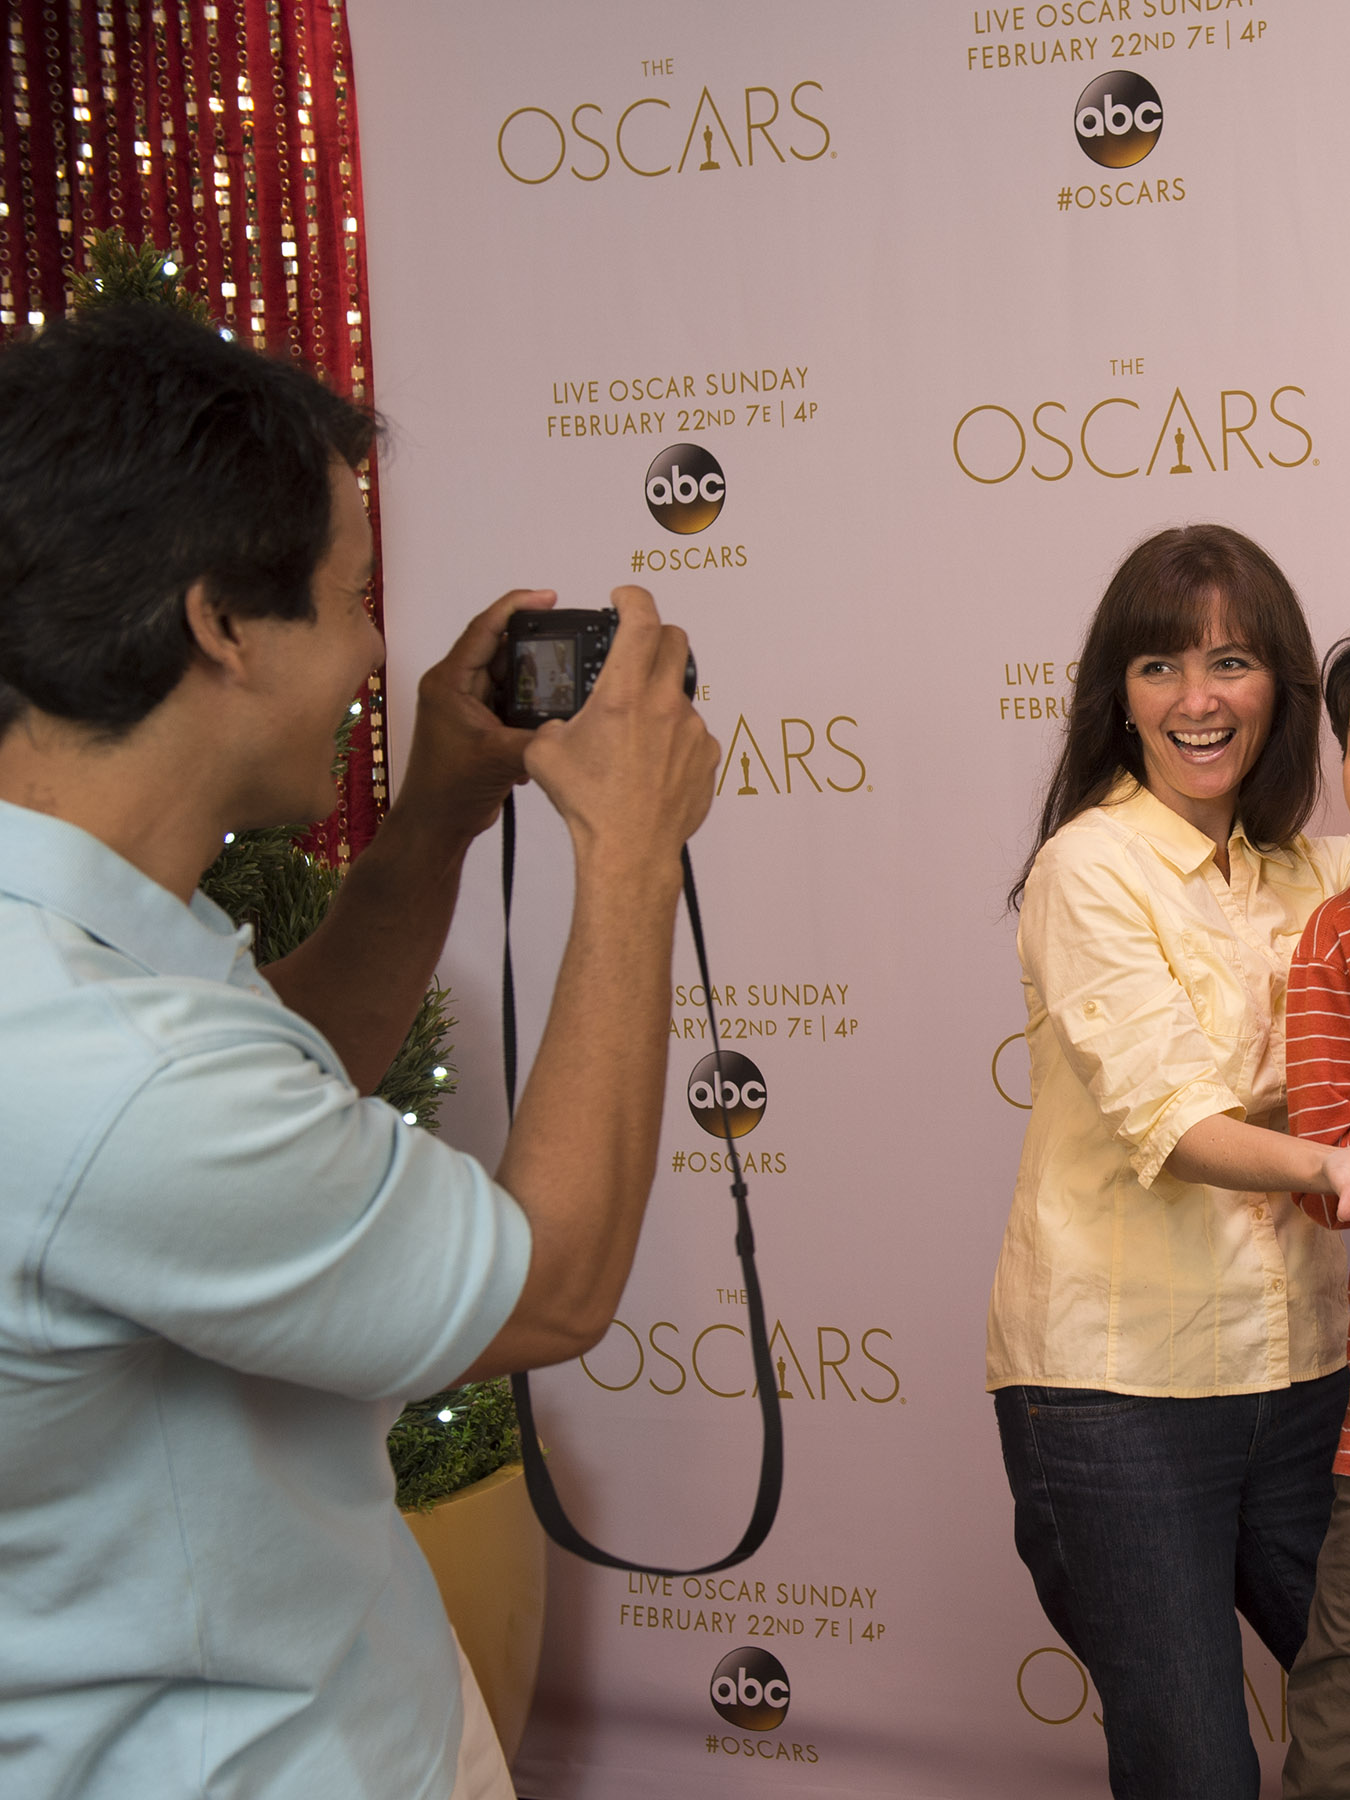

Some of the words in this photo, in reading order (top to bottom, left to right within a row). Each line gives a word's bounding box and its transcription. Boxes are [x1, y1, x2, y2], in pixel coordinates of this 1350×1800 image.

[974, 7, 1025, 34] LIVE
[1036, 0, 1132, 28] OSCAR
[1143, 0, 1253, 18] SUN
[967, 37, 1098, 71] FEBRUARY
[1111, 31, 1176, 58] 22ND
[1187, 25, 1216, 50] 7E
[1240, 19, 1268, 43] 4P
[641, 58, 675, 77] THE
[1076, 93, 1163, 138] abc
[1057, 177, 1187, 212] #OSCARS
[1109, 357, 1145, 376] THE
[552, 381, 599, 404] LIVE
[609, 375, 696, 402] OSCAR
[706, 367, 809, 396] SUNDAY
[547, 411, 666, 438] FEBRUARY
[677, 409, 736, 432] 22ND
[746, 404, 772, 427] 7E
[793, 401, 818, 423] 4P
[646, 465, 725, 505] abc
[631, 545, 748, 573] #OSCARS
[1005, 662, 1055, 686] LIVE
[675, 984, 738, 1007] SCAR
[747, 983, 849, 1007] SUNDAY
[719, 1018, 777, 1039] 22ND
[787, 1017, 813, 1038] 7E
[834, 1017, 859, 1038] 4P
[688, 1071, 766, 1109] abc
[672, 1151, 788, 1174] #OSCARS
[716, 1288, 748, 1304] THE
[628, 1572, 674, 1597] LIVE
[683, 1577, 767, 1604] OSCAR
[776, 1583, 878, 1609] SUNDAY
[620, 1604, 737, 1634] FEBRUARY
[747, 1614, 805, 1637] 22ND
[815, 1618, 840, 1639] 7E
[861, 1621, 886, 1642] 4P
[711, 1667, 789, 1709] abc
[705, 1734, 819, 1764] #OSCARS
